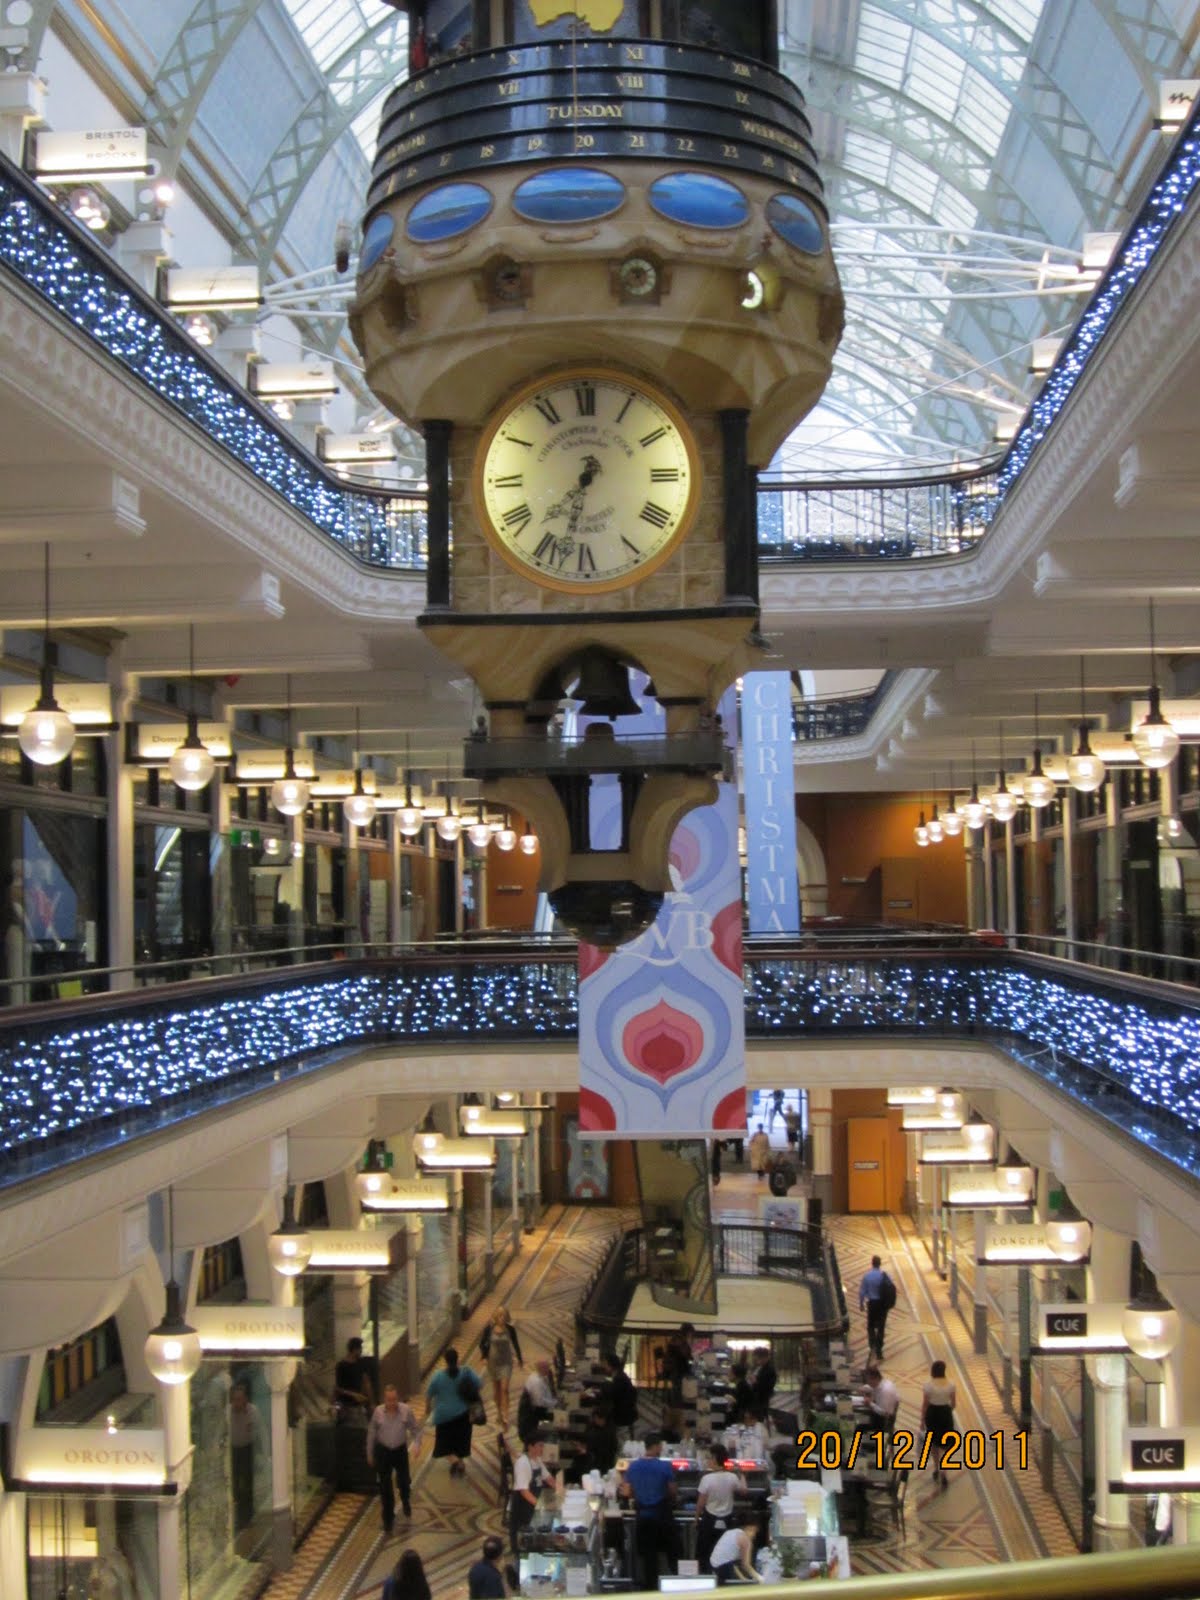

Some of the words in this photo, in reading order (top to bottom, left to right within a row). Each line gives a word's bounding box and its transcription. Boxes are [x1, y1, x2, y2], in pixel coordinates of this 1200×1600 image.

[508, 53, 520, 66] X
[626, 47, 644, 60] XI
[498, 82, 520, 96] VII
[616, 75, 644, 89] VIII
[547, 105, 625, 119] TUESDAY
[86, 130, 140, 140] BRISTOL
[480, 144, 495, 159] 18
[527, 136, 543, 151] 19
[575, 135, 594, 148] 20
[629, 135, 645, 148] 21
[676, 138, 695, 151] 22
[722, 144, 739, 159] 23
[152, 735, 224, 743] Domiue's
[224, 1320, 297, 1334] OROTON
[1054, 1319, 1080, 1332] CUE
[63, 1447, 157, 1465] OROTON
[1141, 1447, 1175, 1463] CUE
